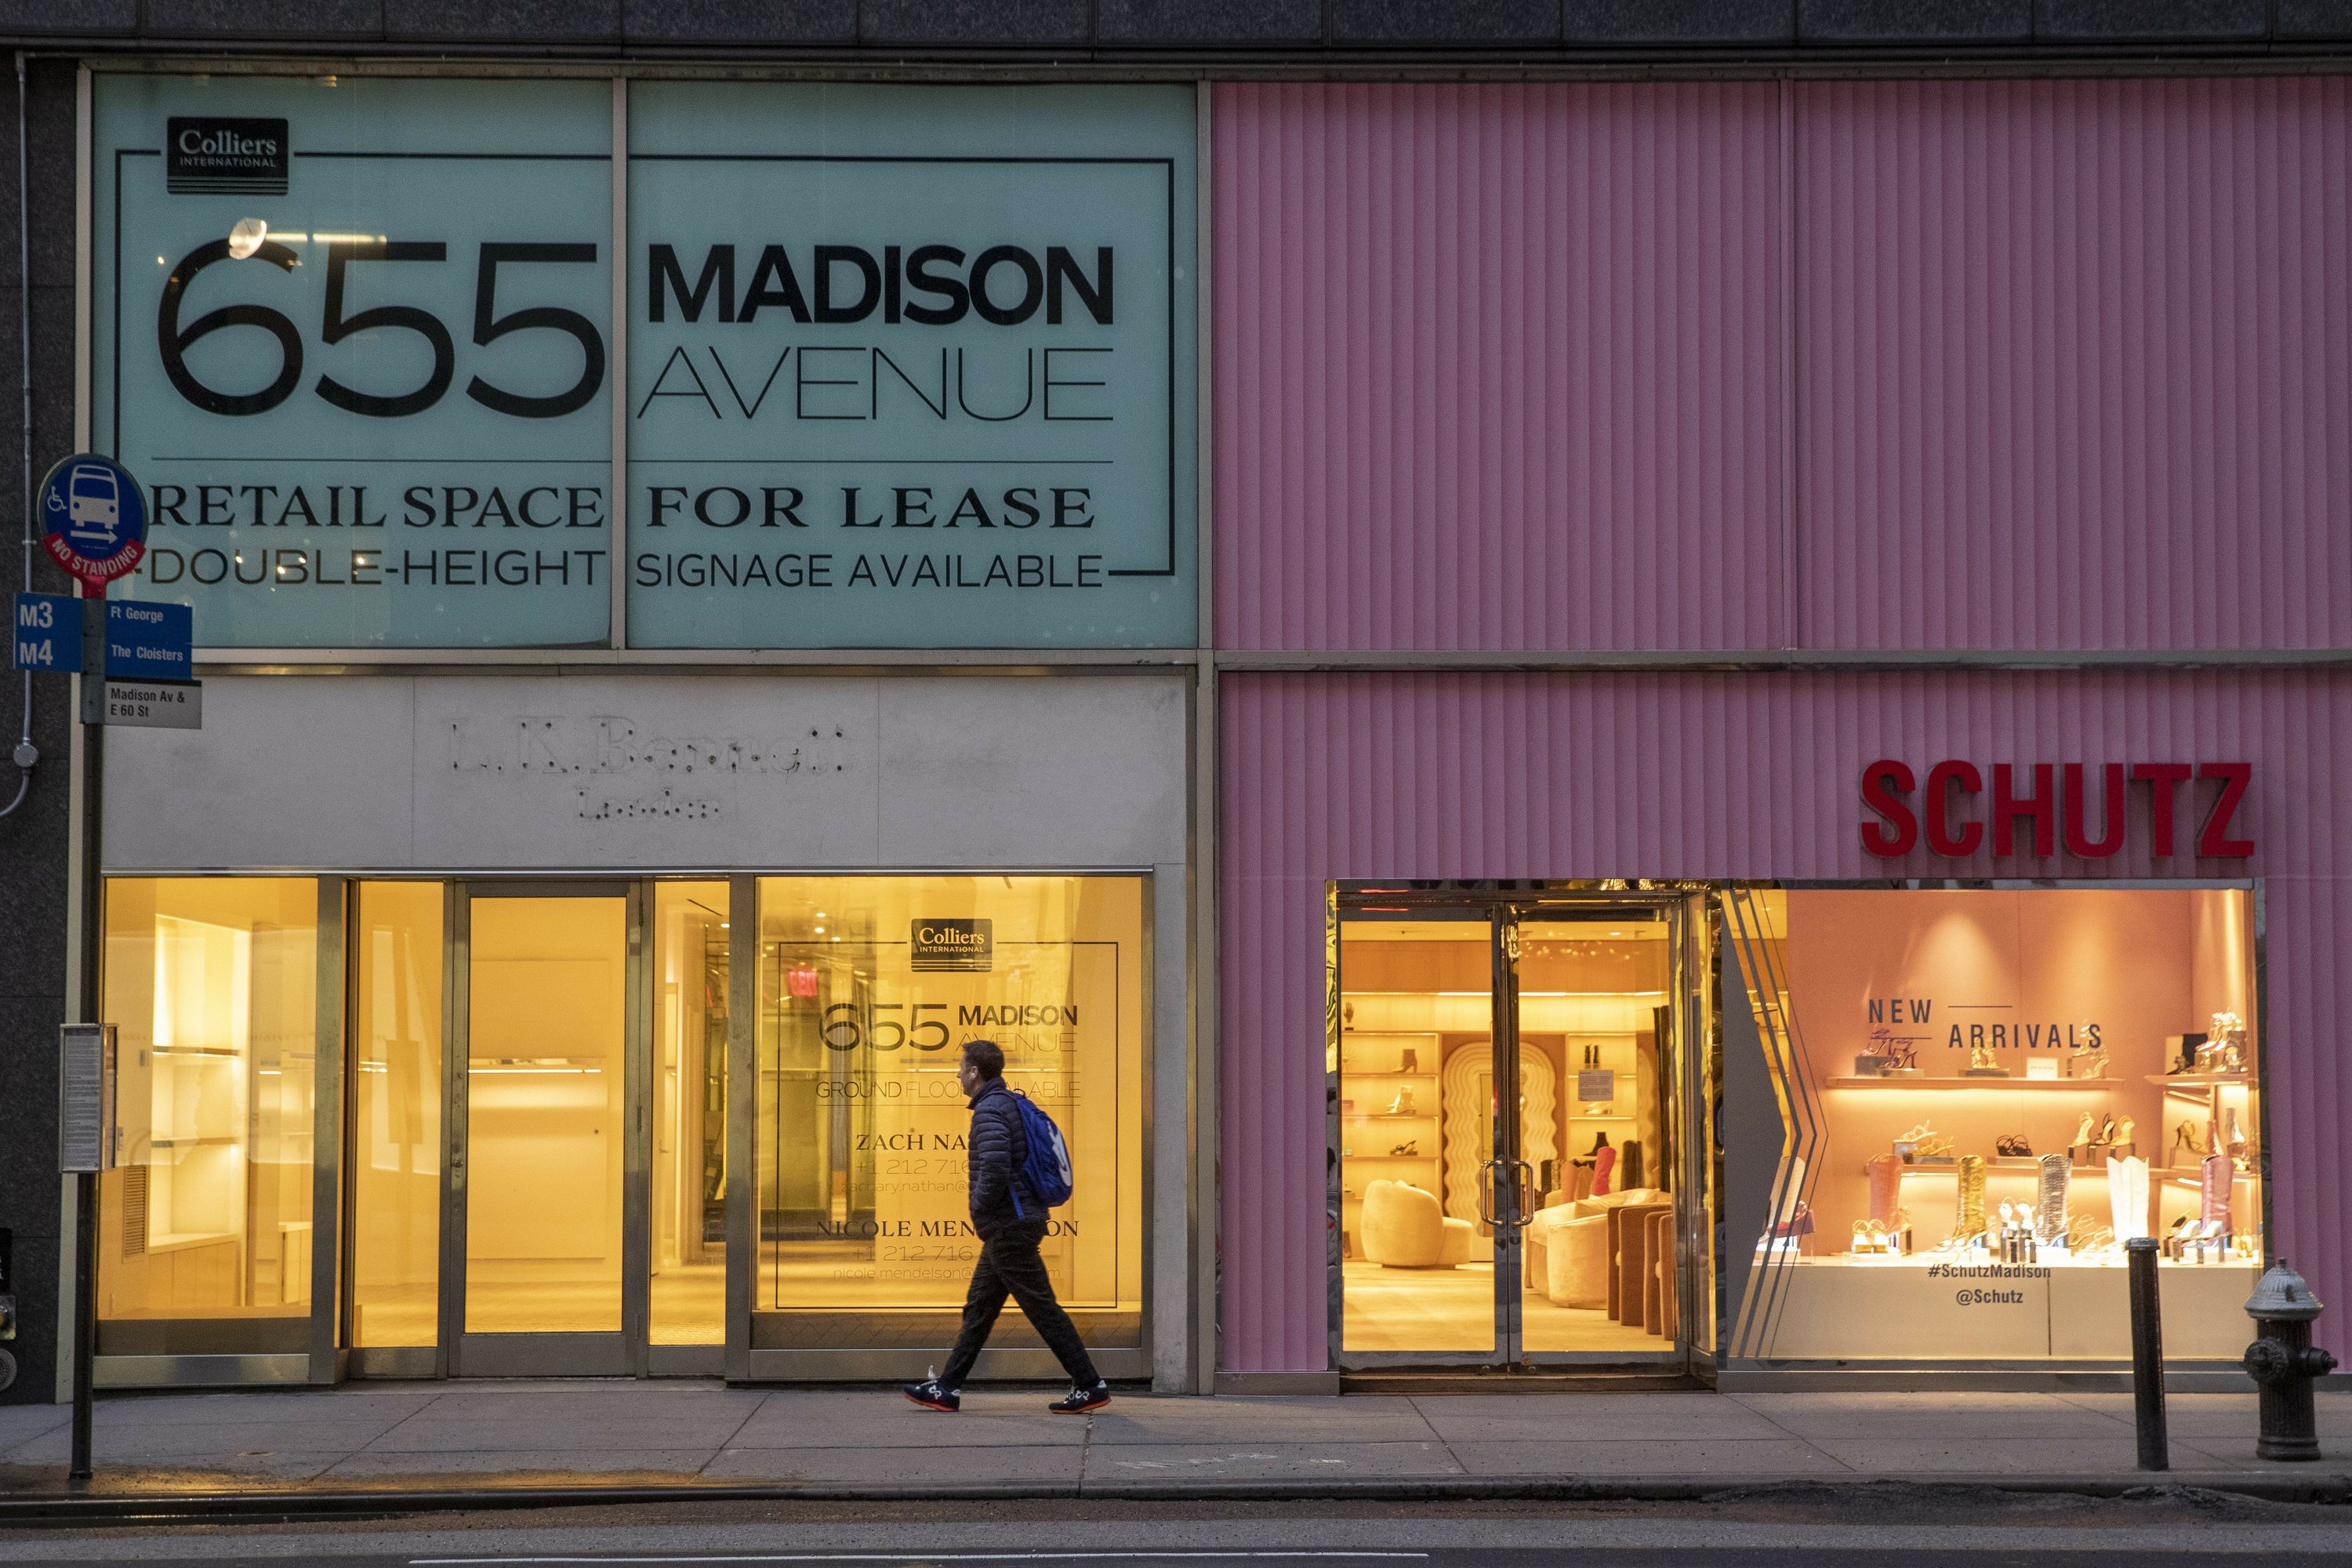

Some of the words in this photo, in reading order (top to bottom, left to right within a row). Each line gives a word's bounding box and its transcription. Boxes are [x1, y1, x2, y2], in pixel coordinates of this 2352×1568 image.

[180, 129, 277, 155] Colliers
[180, 157, 277, 167] INTERNATIONAL
[648, 244, 1113, 325] MADISON
[158, 238, 605, 418] 655
[637, 346, 1113, 422] AVENUE
[150, 485, 387, 527] RETAIL
[404, 486, 604, 528] SPACE
[647, 487, 808, 528] FOR
[841, 487, 1094, 528] LEASE
[52, 538, 71, 561] NO
[71, 546, 138, 576] STANDING
[151, 548, 606, 586] DOUBLE-HEIGHT
[636, 553, 833, 588] SIGNAGE
[848, 554, 1102, 588] AVAILABLE
[20, 601, 53, 628] M3
[111, 606, 122, 619] Ft
[126, 607, 164, 624] George
[20, 639, 53, 666] M4
[111, 644, 132, 658] The
[136, 647, 183, 662] Cloisters
[111, 688, 156, 702] Madison
[159, 691, 173, 702] Av
[177, 691, 185, 703] &
[111, 704, 117, 716] E
[121, 705, 134, 717] 60
[138, 706, 149, 717] St
[1860, 759, 2256, 861] SCHUTZ
[919, 927, 985, 945] Colliers
[959, 1005, 1078, 1026] MADISON
[1868, 999, 1932, 1024] NEW
[819, 1003, 950, 1051] 655
[1948, 1023, 2103, 1049] ARRIVALS
[816, 1081, 902, 1098] GROUND
[855, 1134, 924, 1151] ZACH
[855, 1159, 880, 1174] +1
[886, 1159, 928, 1174] 212
[815, 1220, 912, 1237] NICOLE
[920, 1220, 1079, 1237] MENON
[852, 1246, 877, 1261] +1
[883, 1245, 925, 1261] 212
[931, 1245, 974, 1261] 716
[1928, 1264, 2051, 1278] #SchutzMadison
[1956, 1288, 2024, 1305] @Schutz
